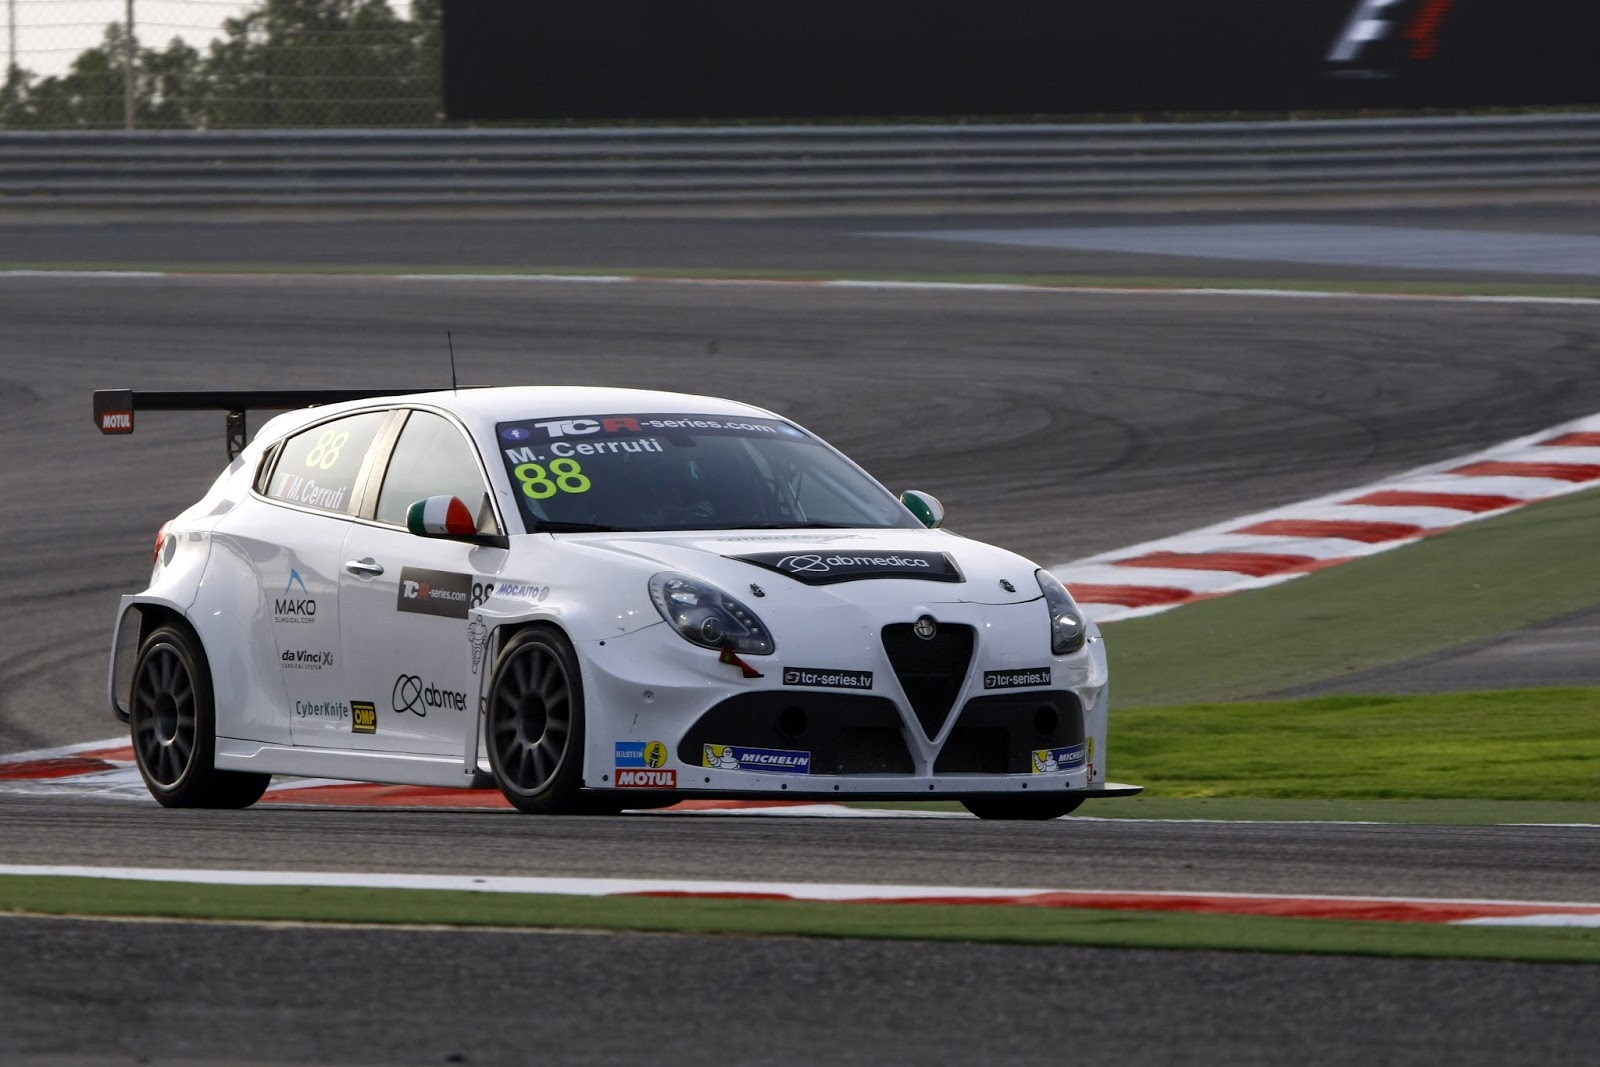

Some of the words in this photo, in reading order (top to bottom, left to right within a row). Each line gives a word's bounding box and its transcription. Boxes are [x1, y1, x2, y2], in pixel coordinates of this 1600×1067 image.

[102, 414, 131, 428] MOTUL
[534, 417, 776, 438] TCR-series.com
[305, 429, 350, 470] 88
[505, 446, 545, 464] M.
[550, 438, 664, 458] Cerruti
[513, 457, 592, 500] 88
[287, 476, 304, 500] M.
[301, 479, 347, 510] Cerruti
[274, 599, 317, 616] MAKO
[274, 616, 301, 624] SURGICAL
[281, 649, 296, 662] da
[296, 650, 322, 663] Vinci
[801, 671, 872, 687] tcr-series.tv
[997, 672, 1051, 687] tcr-series.tv
[296, 701, 349, 720] CyberKnife
[354, 709, 375, 725] OMP
[741, 753, 809, 766] MICHELIN
[618, 771, 675, 786] MOTUL
